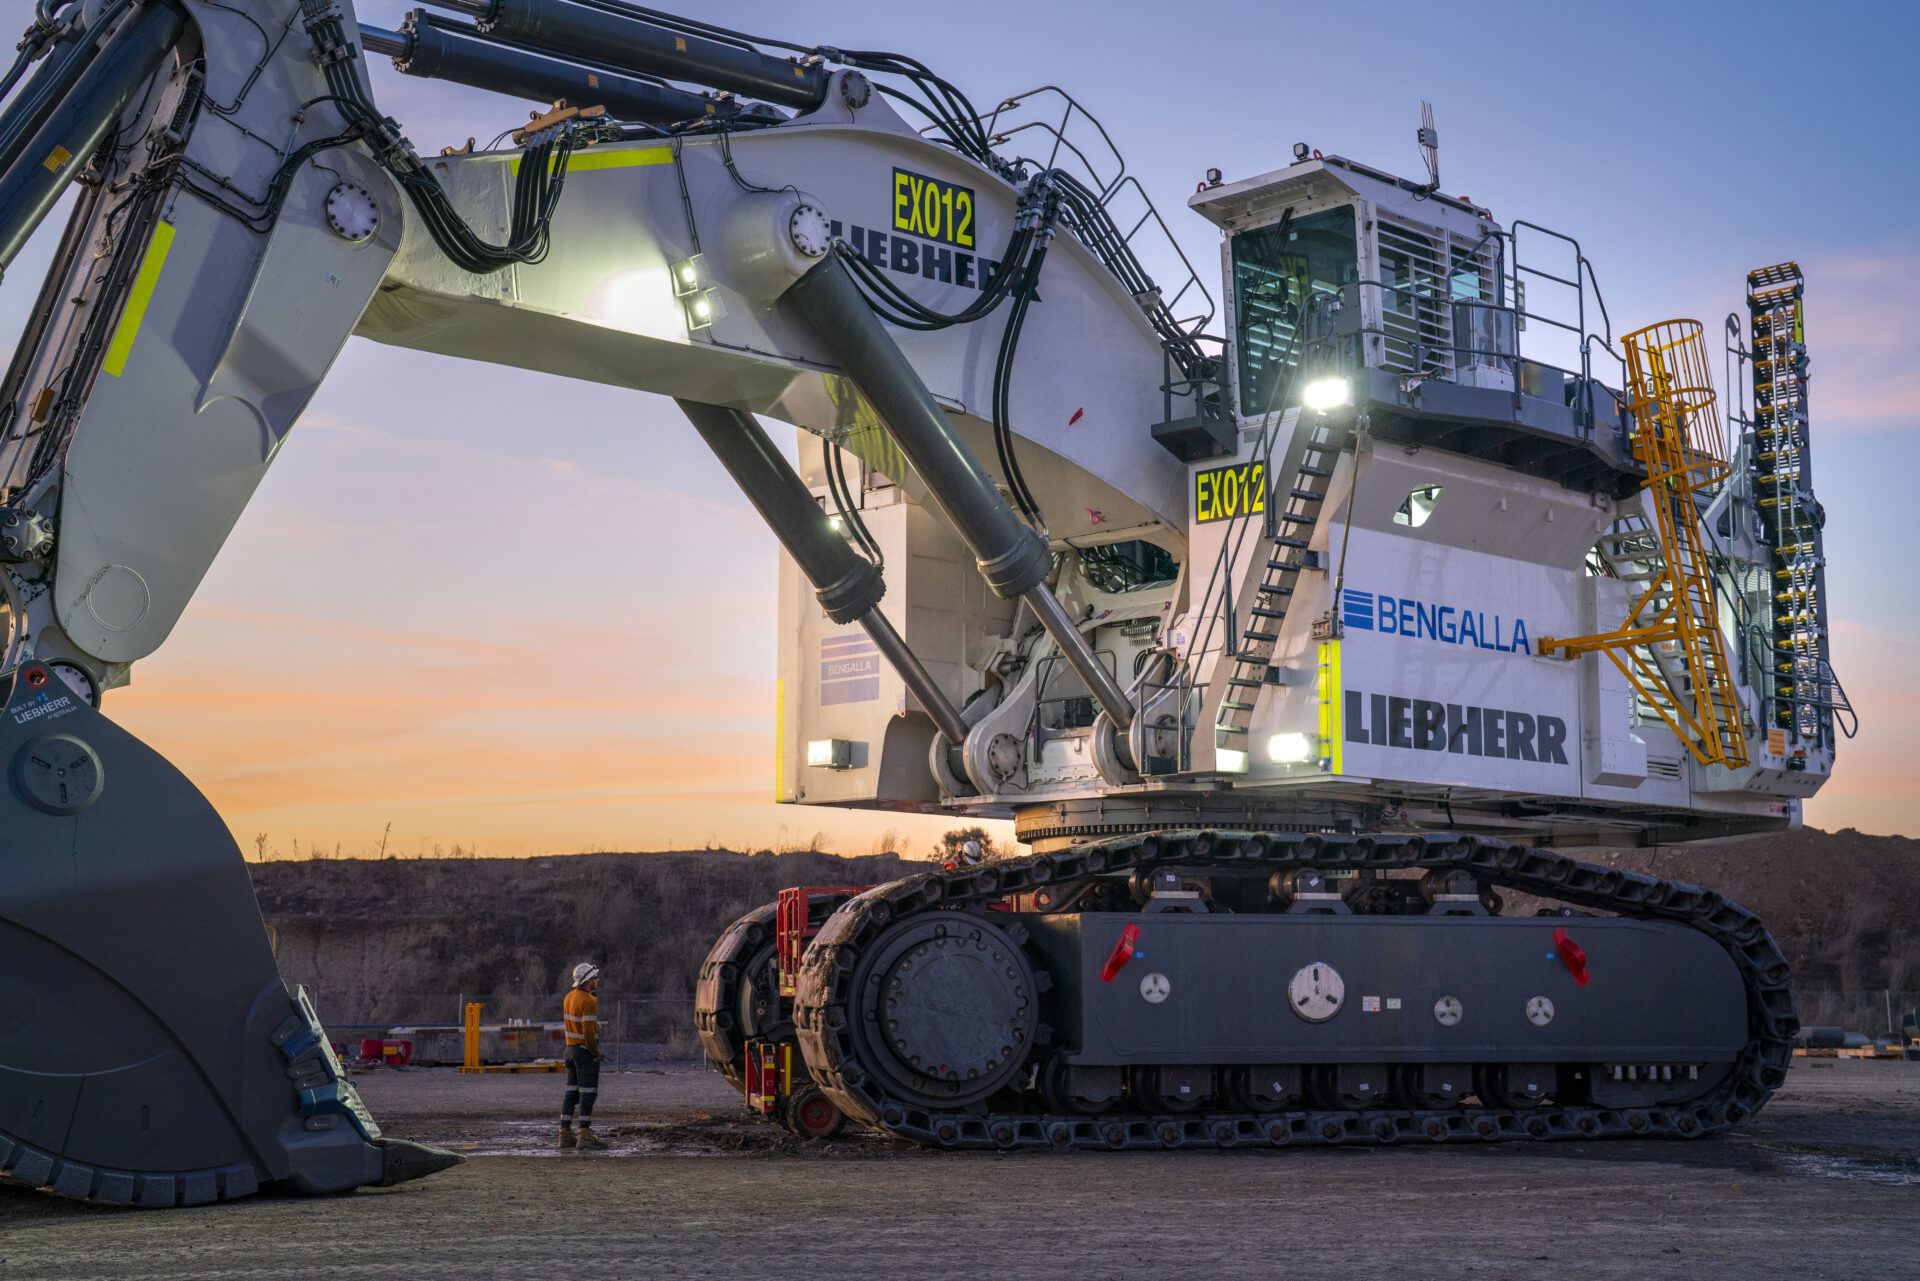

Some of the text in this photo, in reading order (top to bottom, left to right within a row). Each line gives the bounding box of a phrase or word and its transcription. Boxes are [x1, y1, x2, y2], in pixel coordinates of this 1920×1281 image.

[895, 172, 973, 247] EX012
[1197, 464, 1265, 521] EX012
[1378, 595, 1531, 655] BENGALLA
[828, 660, 872, 675] BENGALLA
[10, 700, 36, 714] BUILT BY
[14, 696, 71, 724] LIEBHERR
[1345, 690, 1569, 765] LIEBHERR
